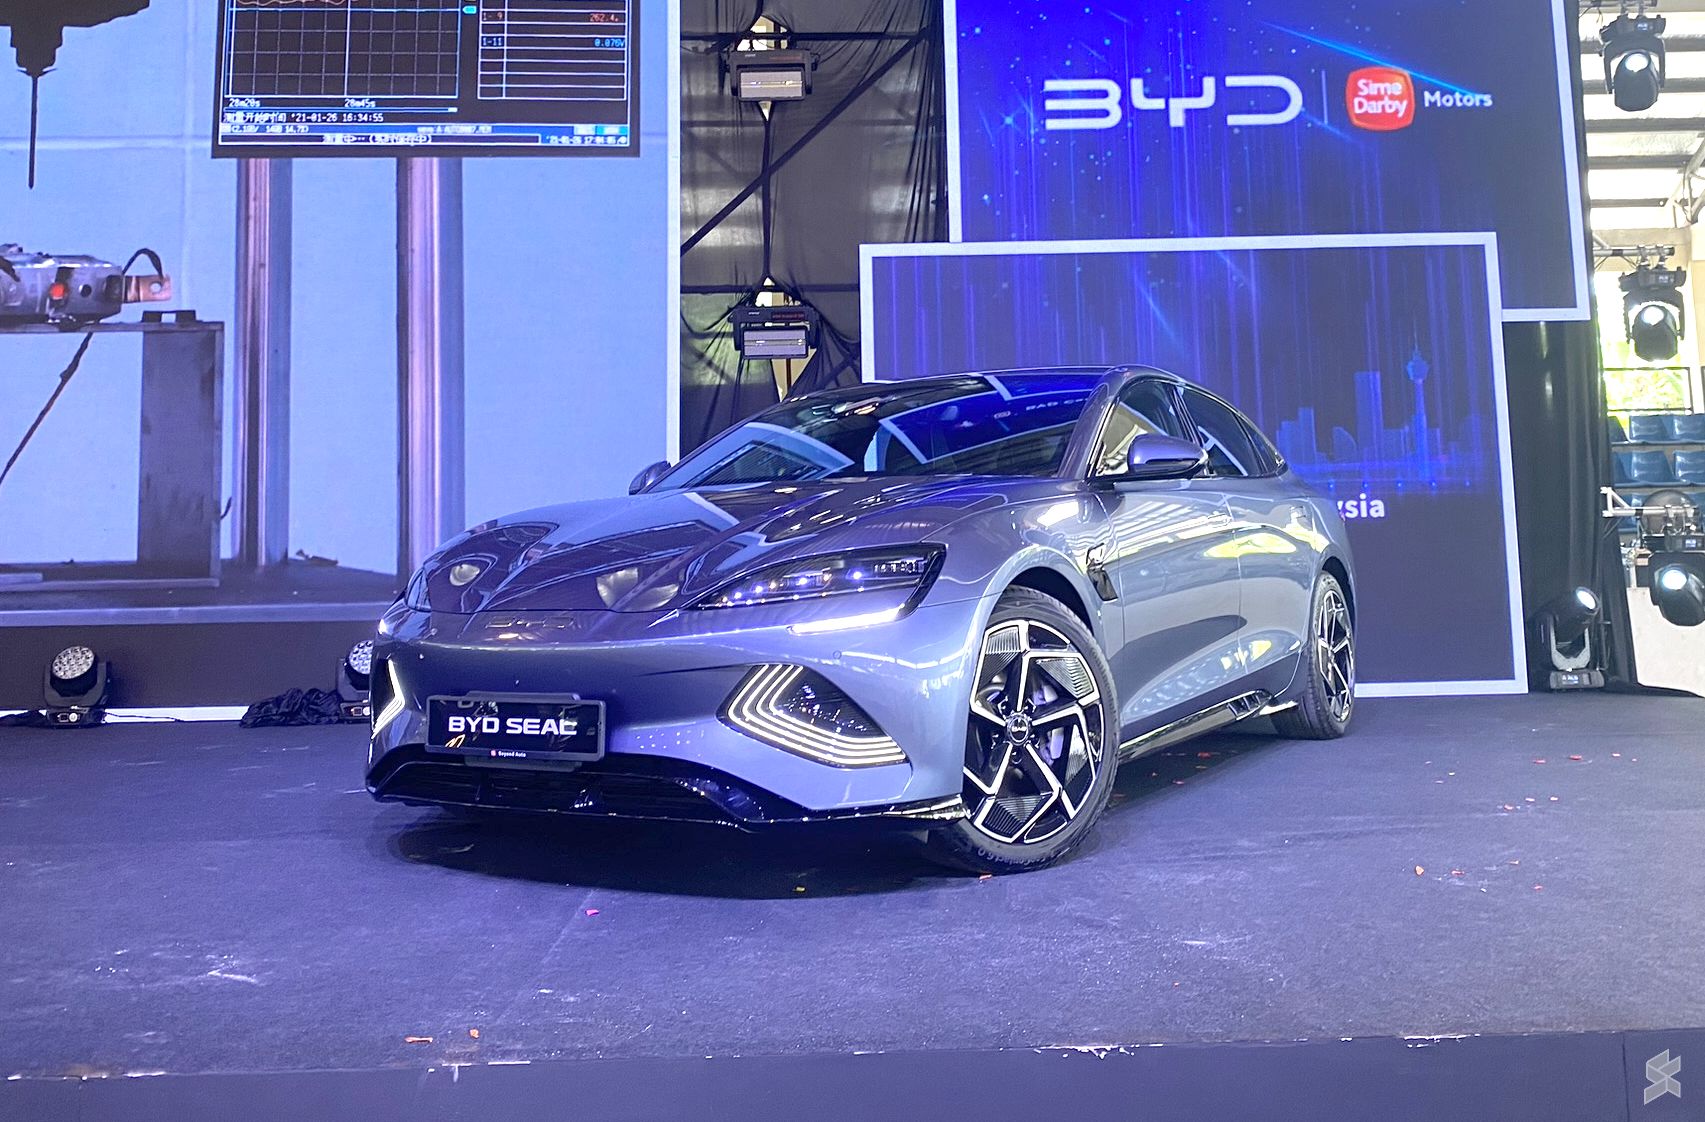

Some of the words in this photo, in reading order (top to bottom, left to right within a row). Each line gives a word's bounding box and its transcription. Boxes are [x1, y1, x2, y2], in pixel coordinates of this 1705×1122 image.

[483, 37, 502, 46] 1-11
[1357, 79, 1402, 96] Sime
[1044, 75, 1303, 130] BYD
[1353, 96, 1407, 118] Darby
[1423, 90, 1493, 107] Motors
[342, 113, 384, 123] 16:34:55
[448, 716, 500, 733] BYD
